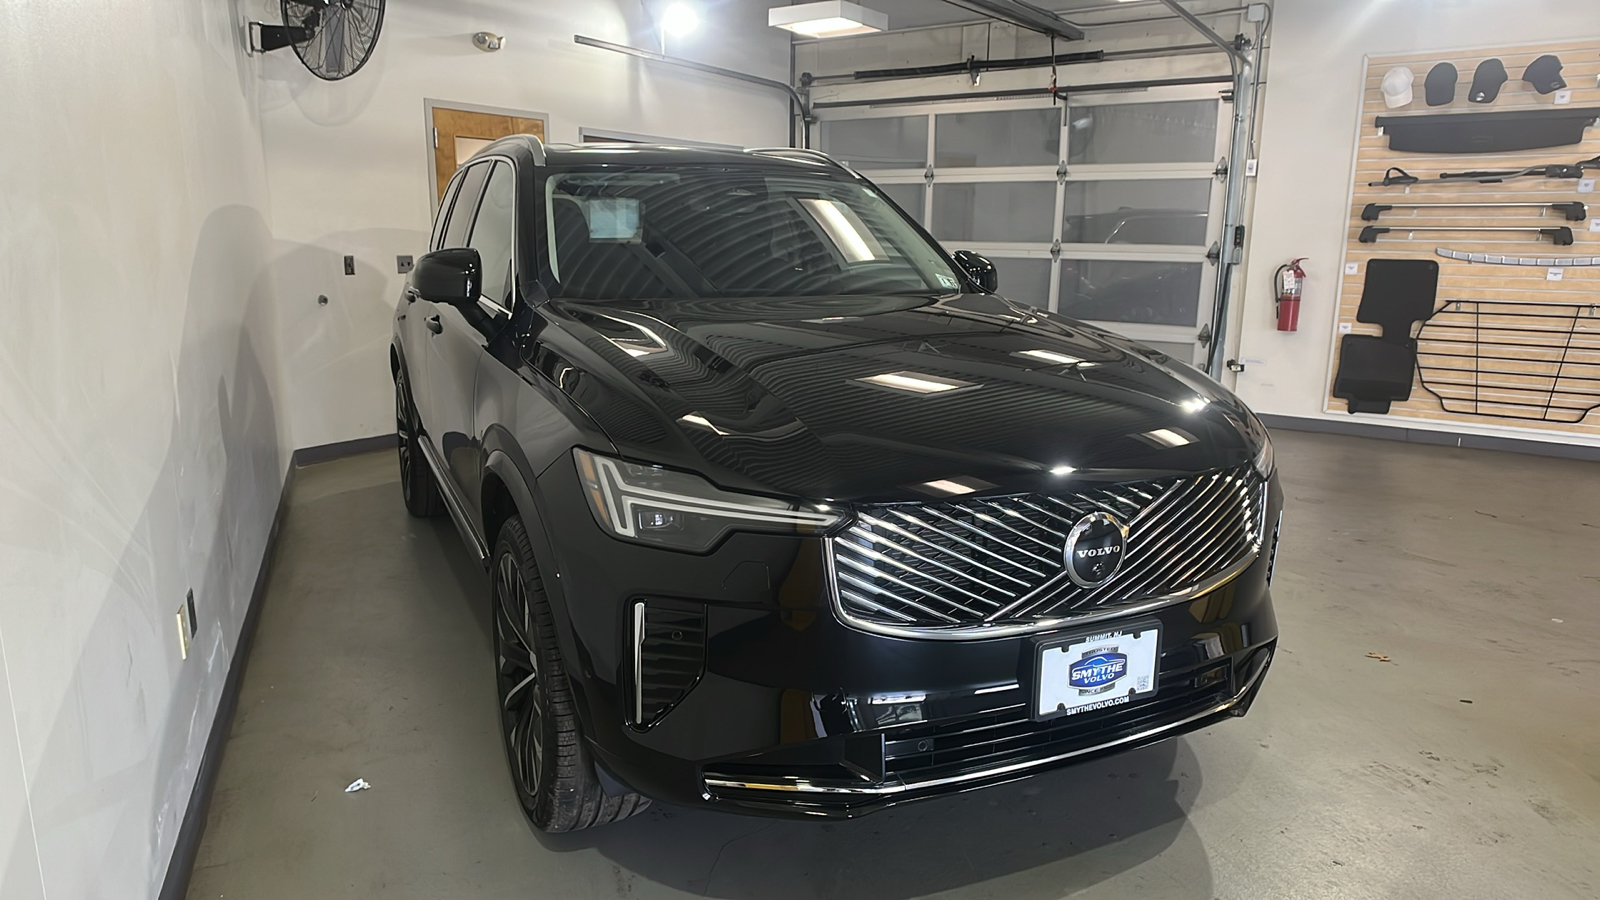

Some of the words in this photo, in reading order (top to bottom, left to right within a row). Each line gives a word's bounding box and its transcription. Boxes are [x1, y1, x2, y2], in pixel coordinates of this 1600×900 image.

[1077, 545, 1120, 558] VOLVO
[1071, 663, 1123, 680] SMYTHE
[1083, 672, 1115, 684] VOLVO
[1066, 696, 1130, 716] SMYTHEVOLVO.COM
